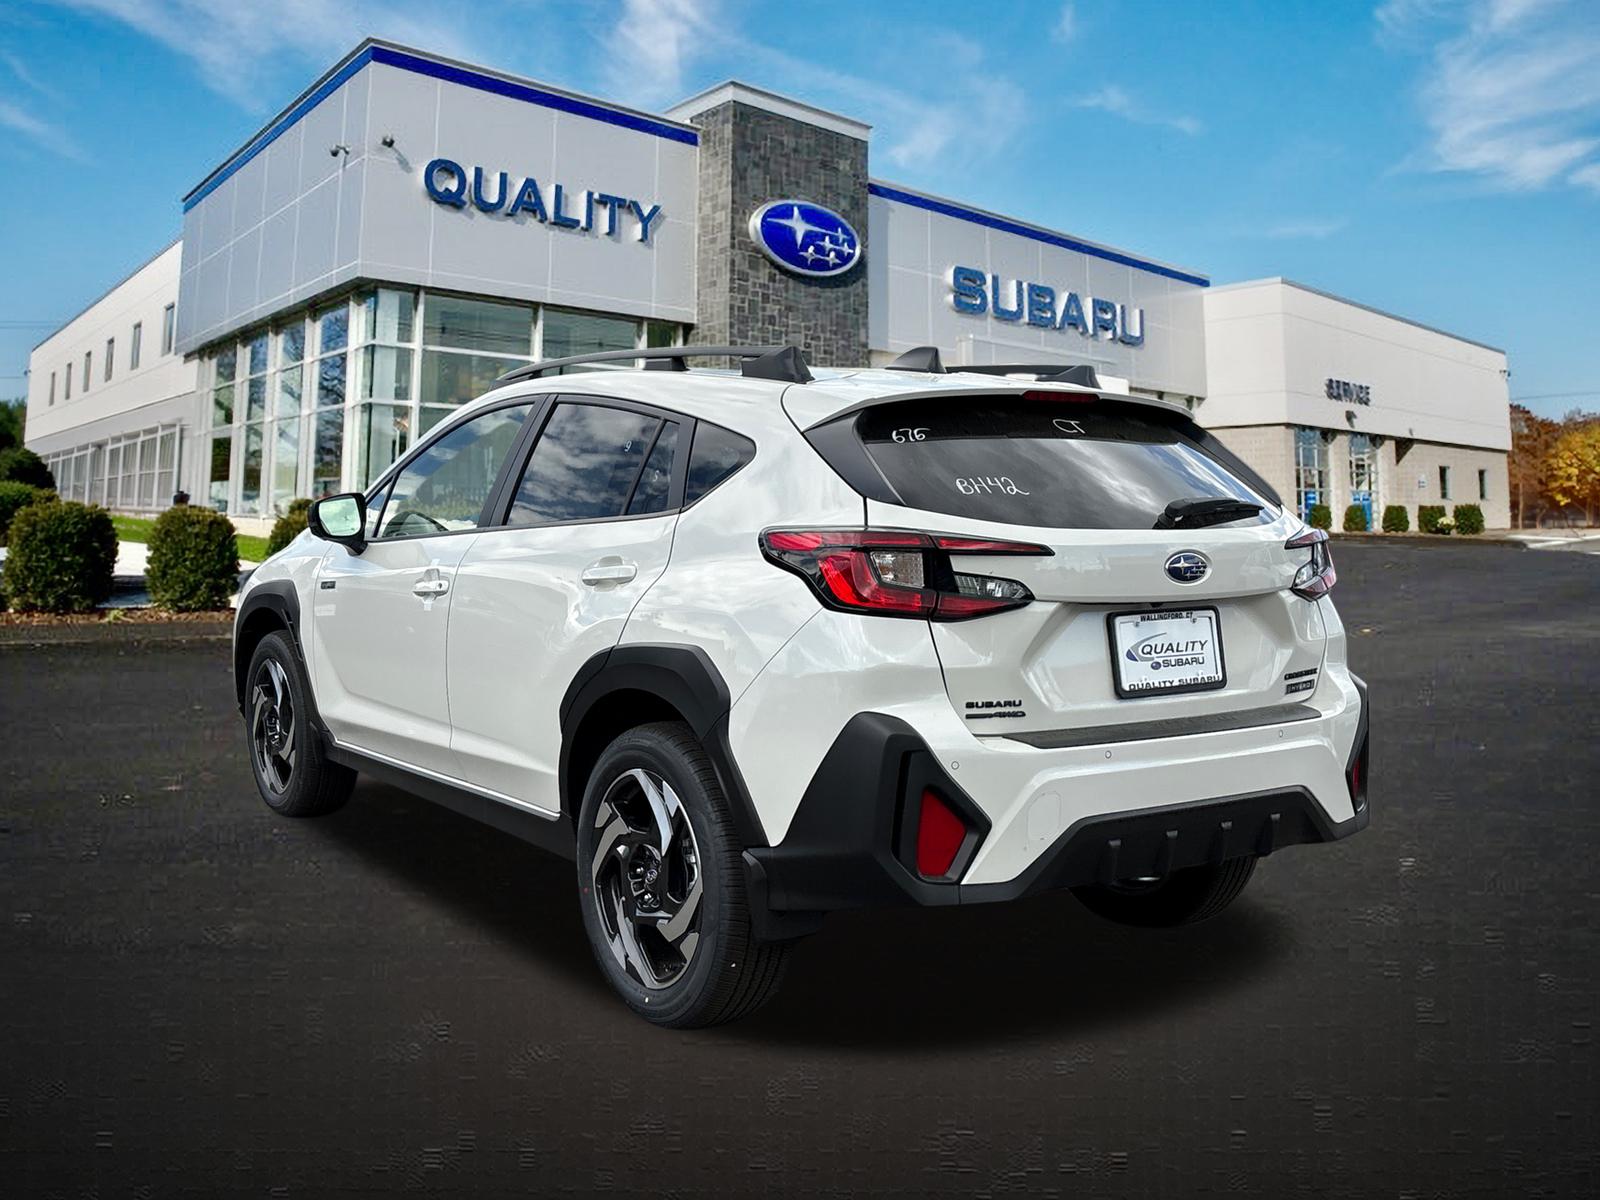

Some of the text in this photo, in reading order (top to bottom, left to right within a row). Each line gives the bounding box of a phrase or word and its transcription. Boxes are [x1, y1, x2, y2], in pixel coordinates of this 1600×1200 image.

[424, 158, 662, 243] QUALITY
[946, 265, 1145, 346] SUBARU
[1141, 640, 1208, 656] QUALITY
[1161, 656, 1205, 668] SUBARU
[1128, 679, 1175, 691] QUALITY
[1178, 674, 1220, 685] SUBARU
[965, 699, 1022, 709] SUBARU
